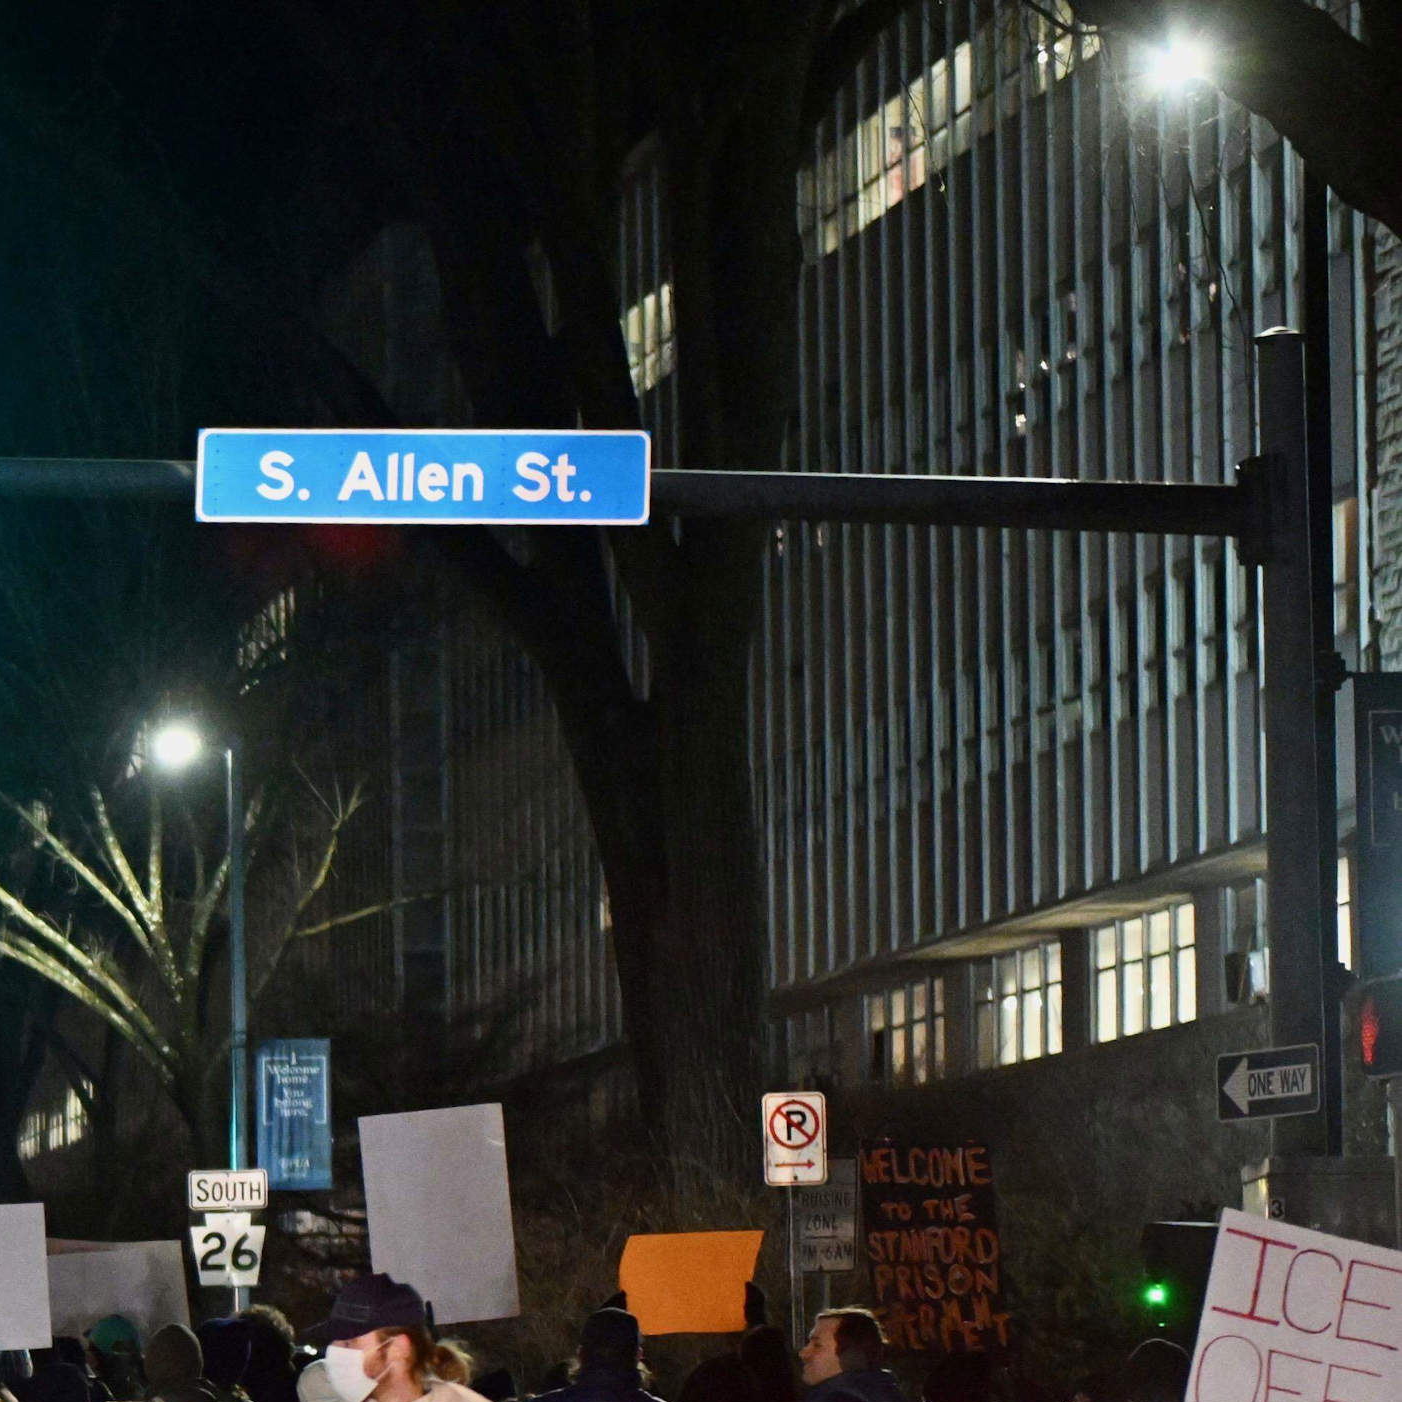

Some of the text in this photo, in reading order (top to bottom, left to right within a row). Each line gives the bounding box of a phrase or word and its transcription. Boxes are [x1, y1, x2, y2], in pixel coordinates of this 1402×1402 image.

[256, 450, 592, 503] S. Allen St.
[1248, 1068, 1307, 1097] ONE WAY
[860, 1147, 994, 1188] WELCOME
[196, 1179, 262, 1202] SOUTH
[880, 1193, 976, 1223] TO THE
[200, 1231, 258, 1272] 26
[874, 1264, 998, 1304] PRISON
[1212, 1228, 1402, 1352] ICE
